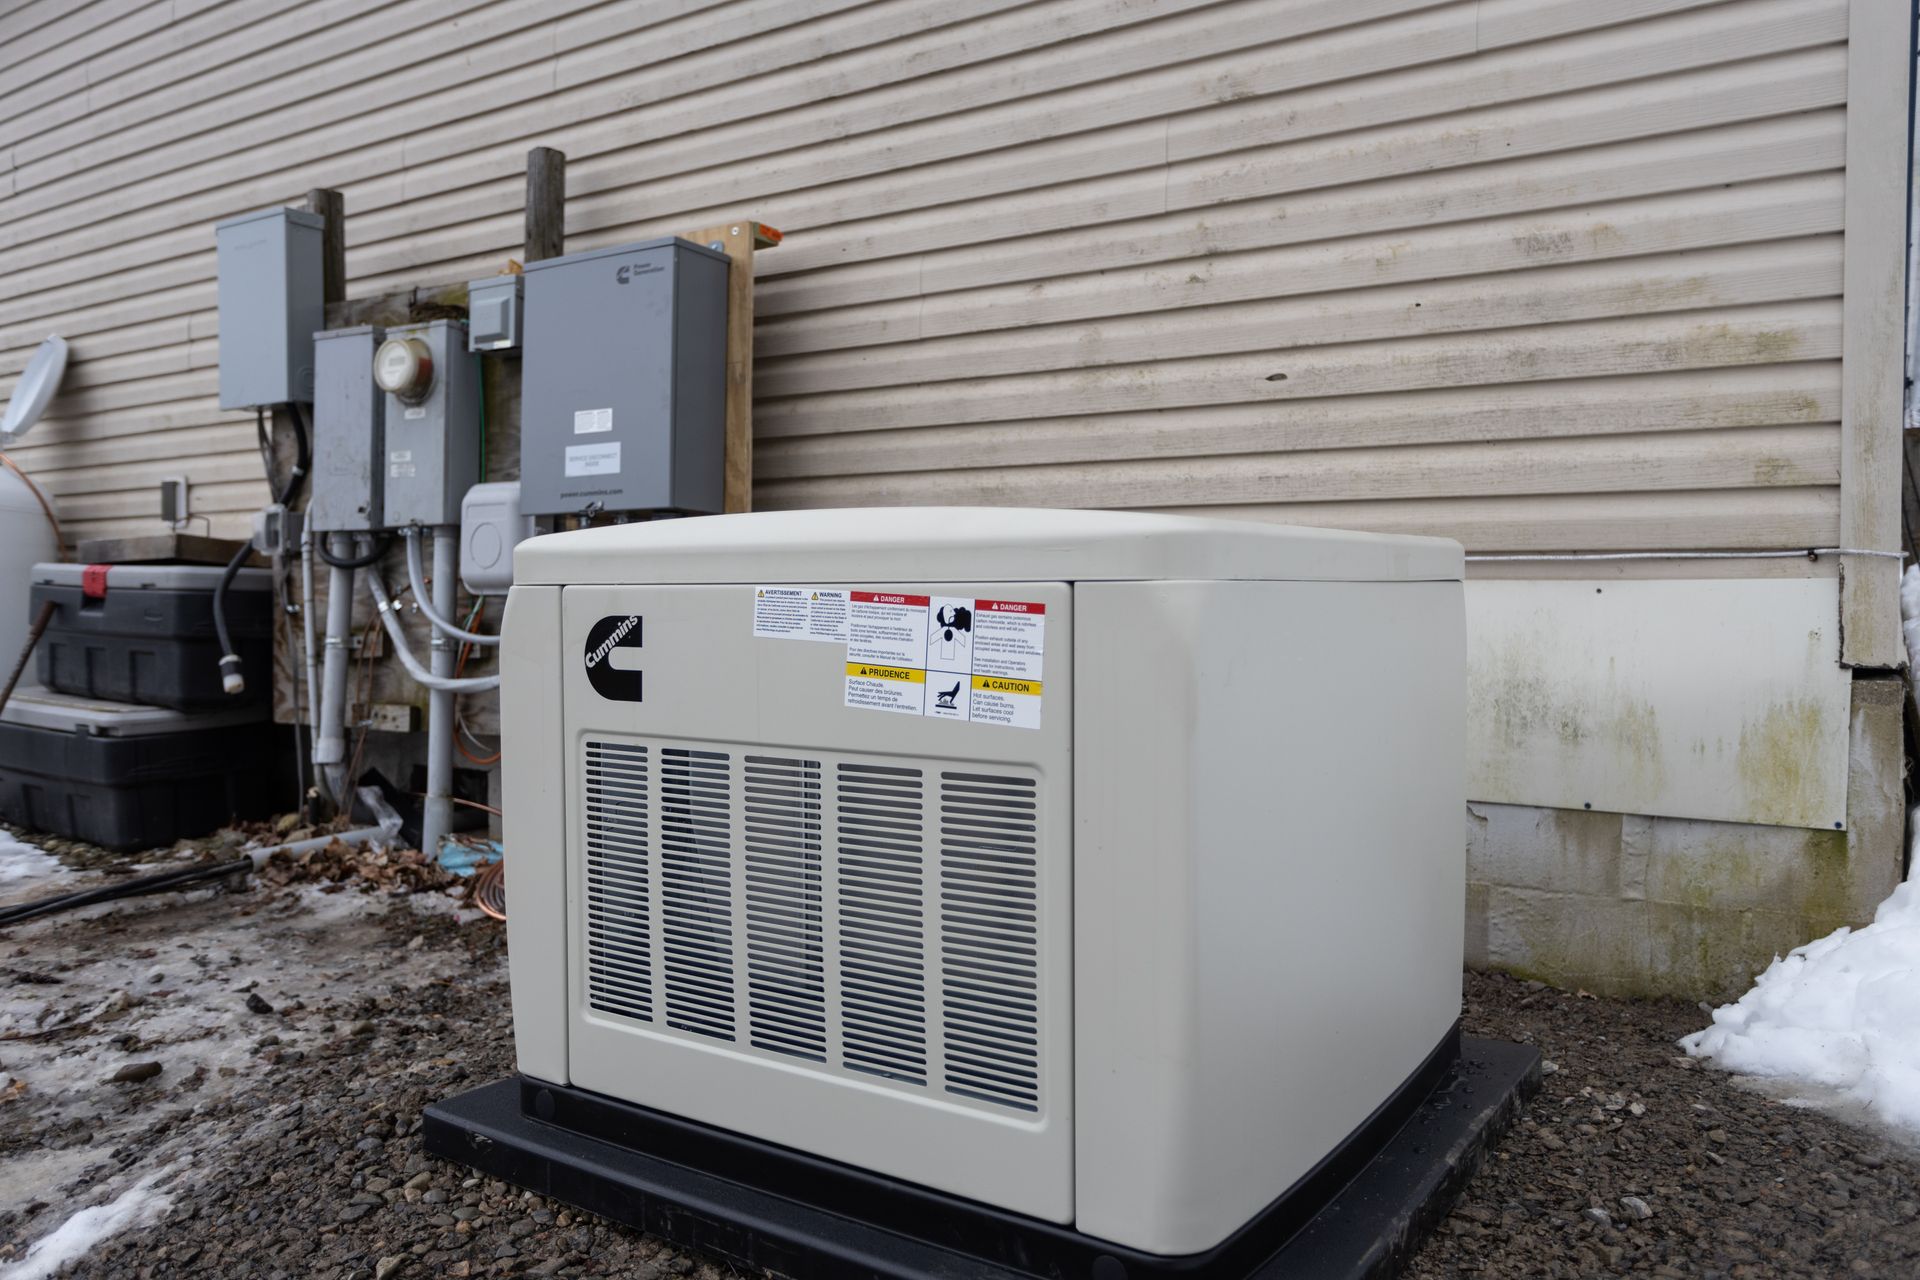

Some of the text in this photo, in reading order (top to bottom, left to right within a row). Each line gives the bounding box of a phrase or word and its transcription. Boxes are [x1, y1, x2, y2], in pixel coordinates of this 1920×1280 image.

[560, 488, 623, 499] power.cummins.com
[1000, 603, 1027, 612] DANGER
[585, 615, 638, 668] Cummins
[869, 668, 910, 679] PRUDENCE
[992, 680, 1030, 692] CAUTION
[848, 691, 869, 699] Permettez
[848, 698, 880, 707] refroidissement
[981, 707, 1002, 715] surfaces
